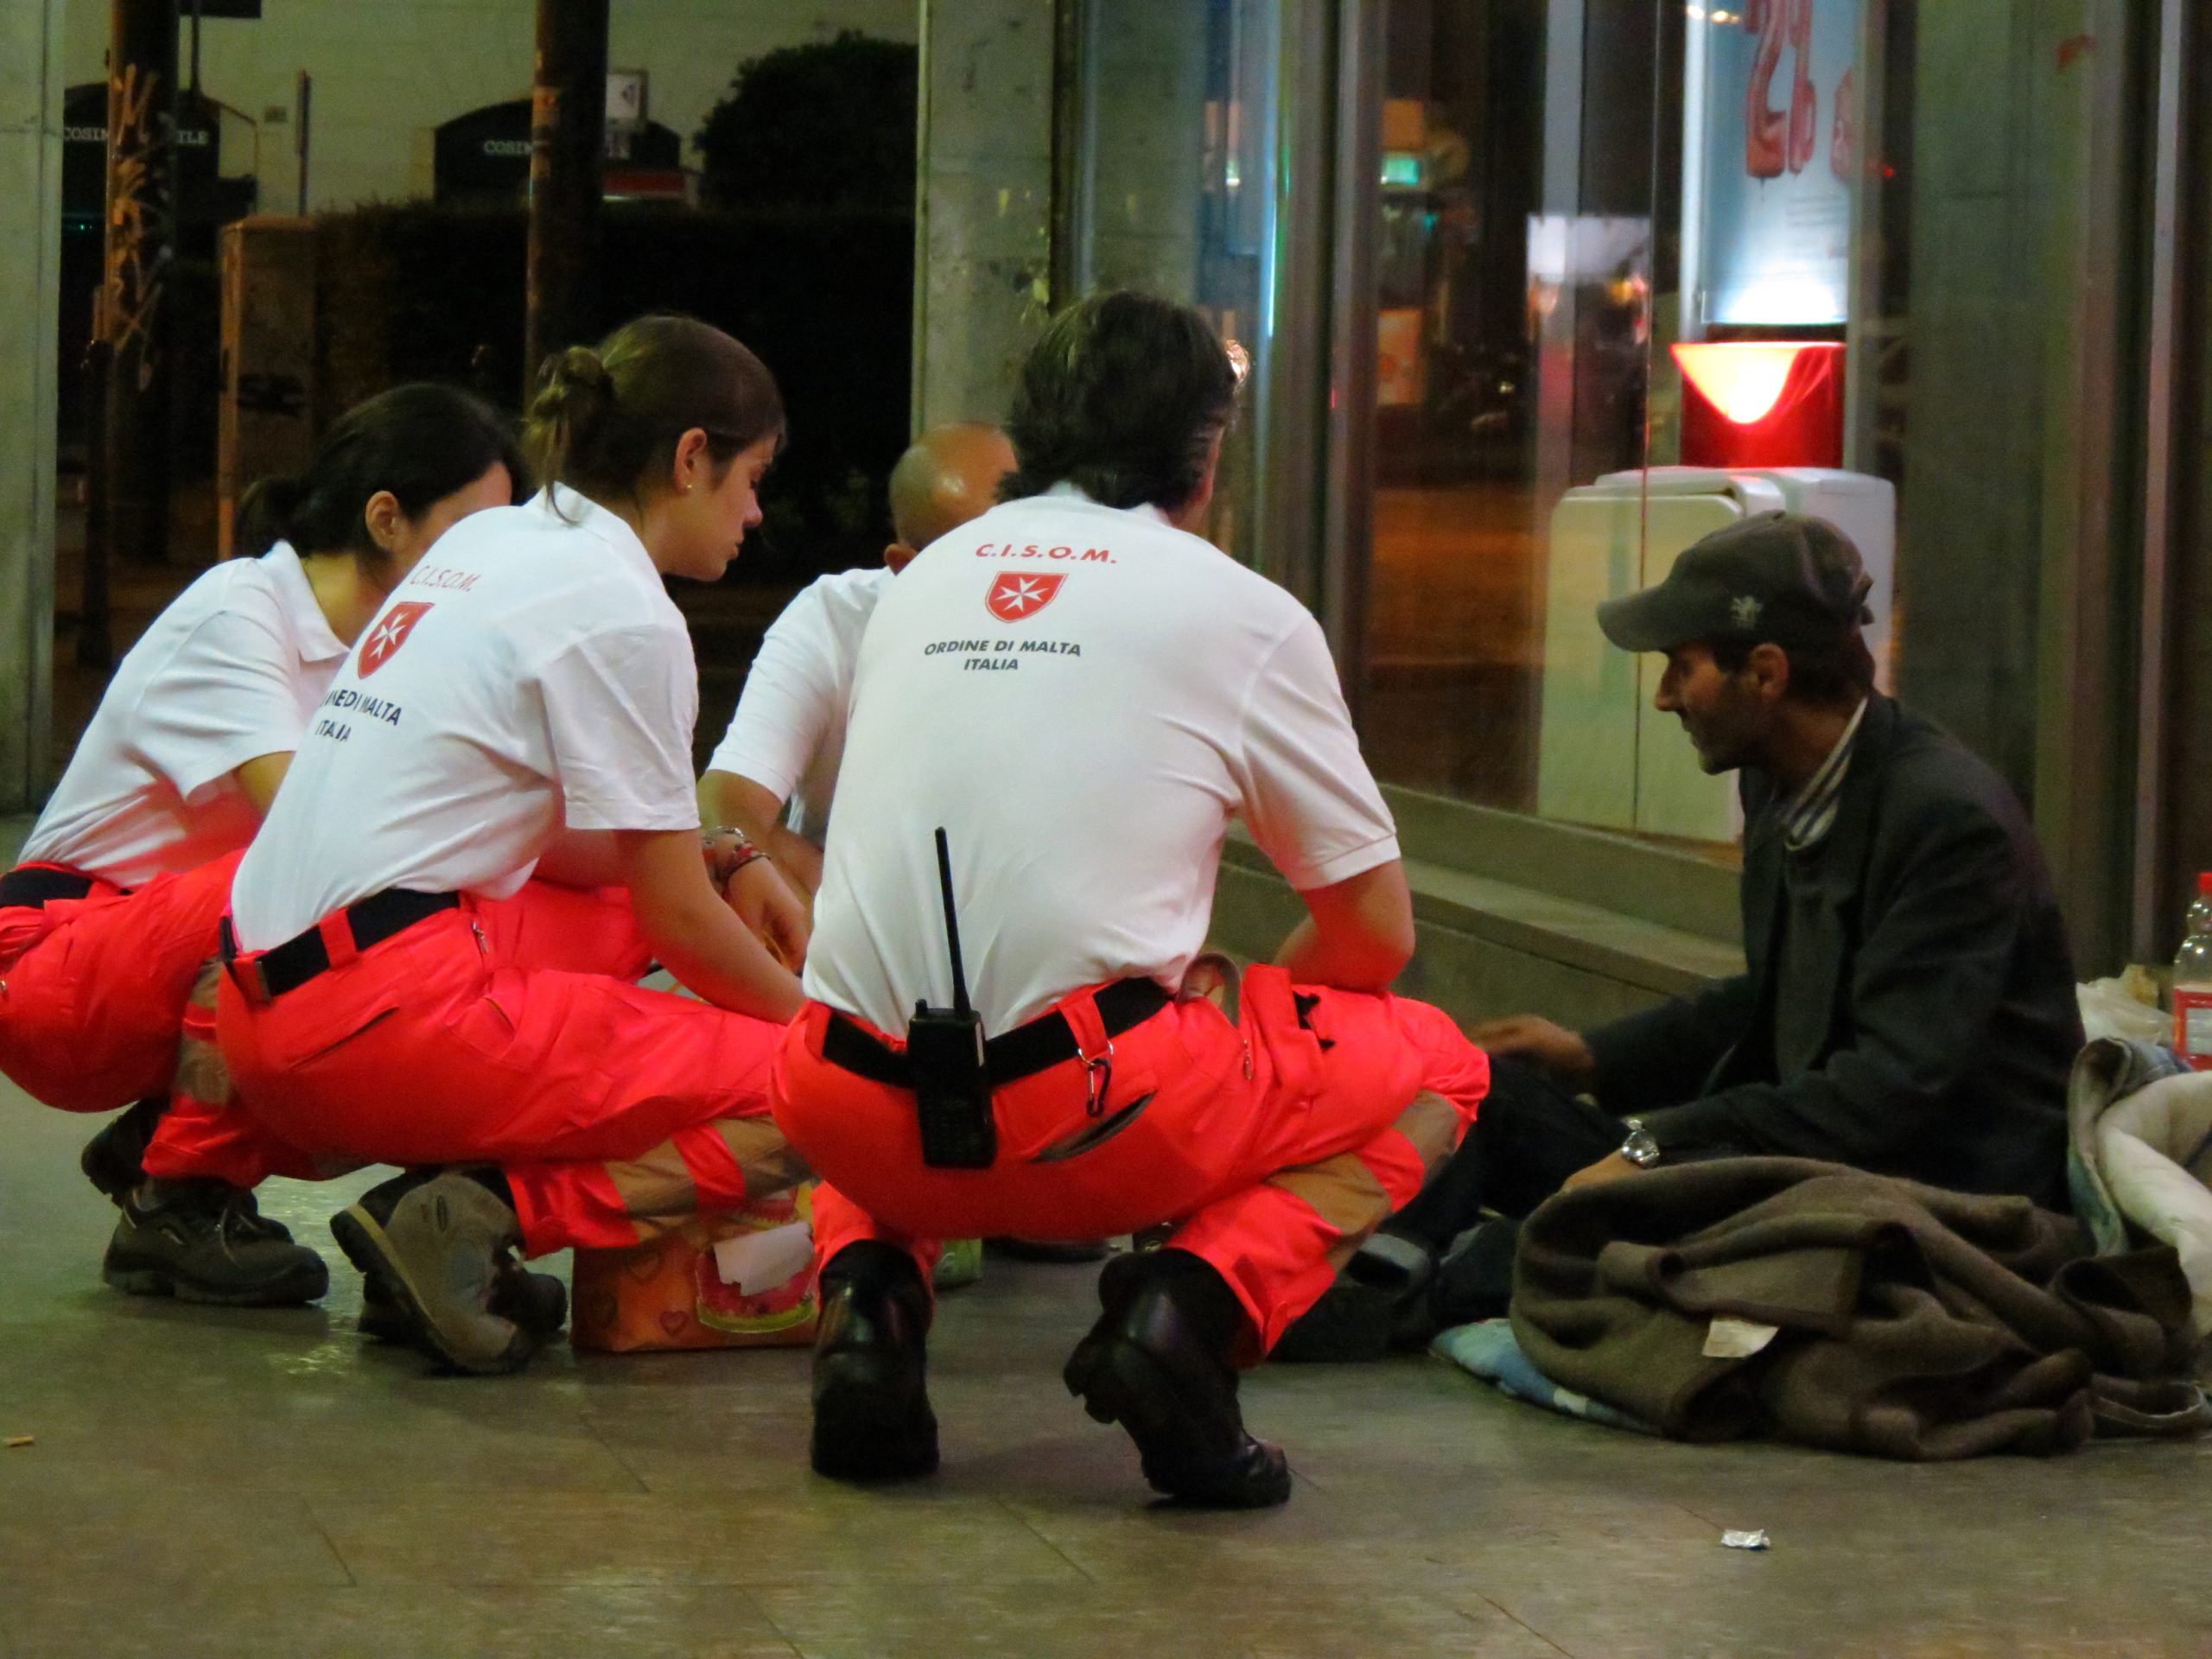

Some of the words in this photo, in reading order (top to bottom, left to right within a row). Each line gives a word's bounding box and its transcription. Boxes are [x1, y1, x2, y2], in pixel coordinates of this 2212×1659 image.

[976, 543, 1117, 563] C.I.S.O.M.
[924, 639, 989, 655] ORDINE
[994, 640, 1014, 652] DI
[1020, 640, 1081, 657] MALTA
[963, 658, 1019, 671] ITALIA
[359, 695, 402, 726] MALTA
